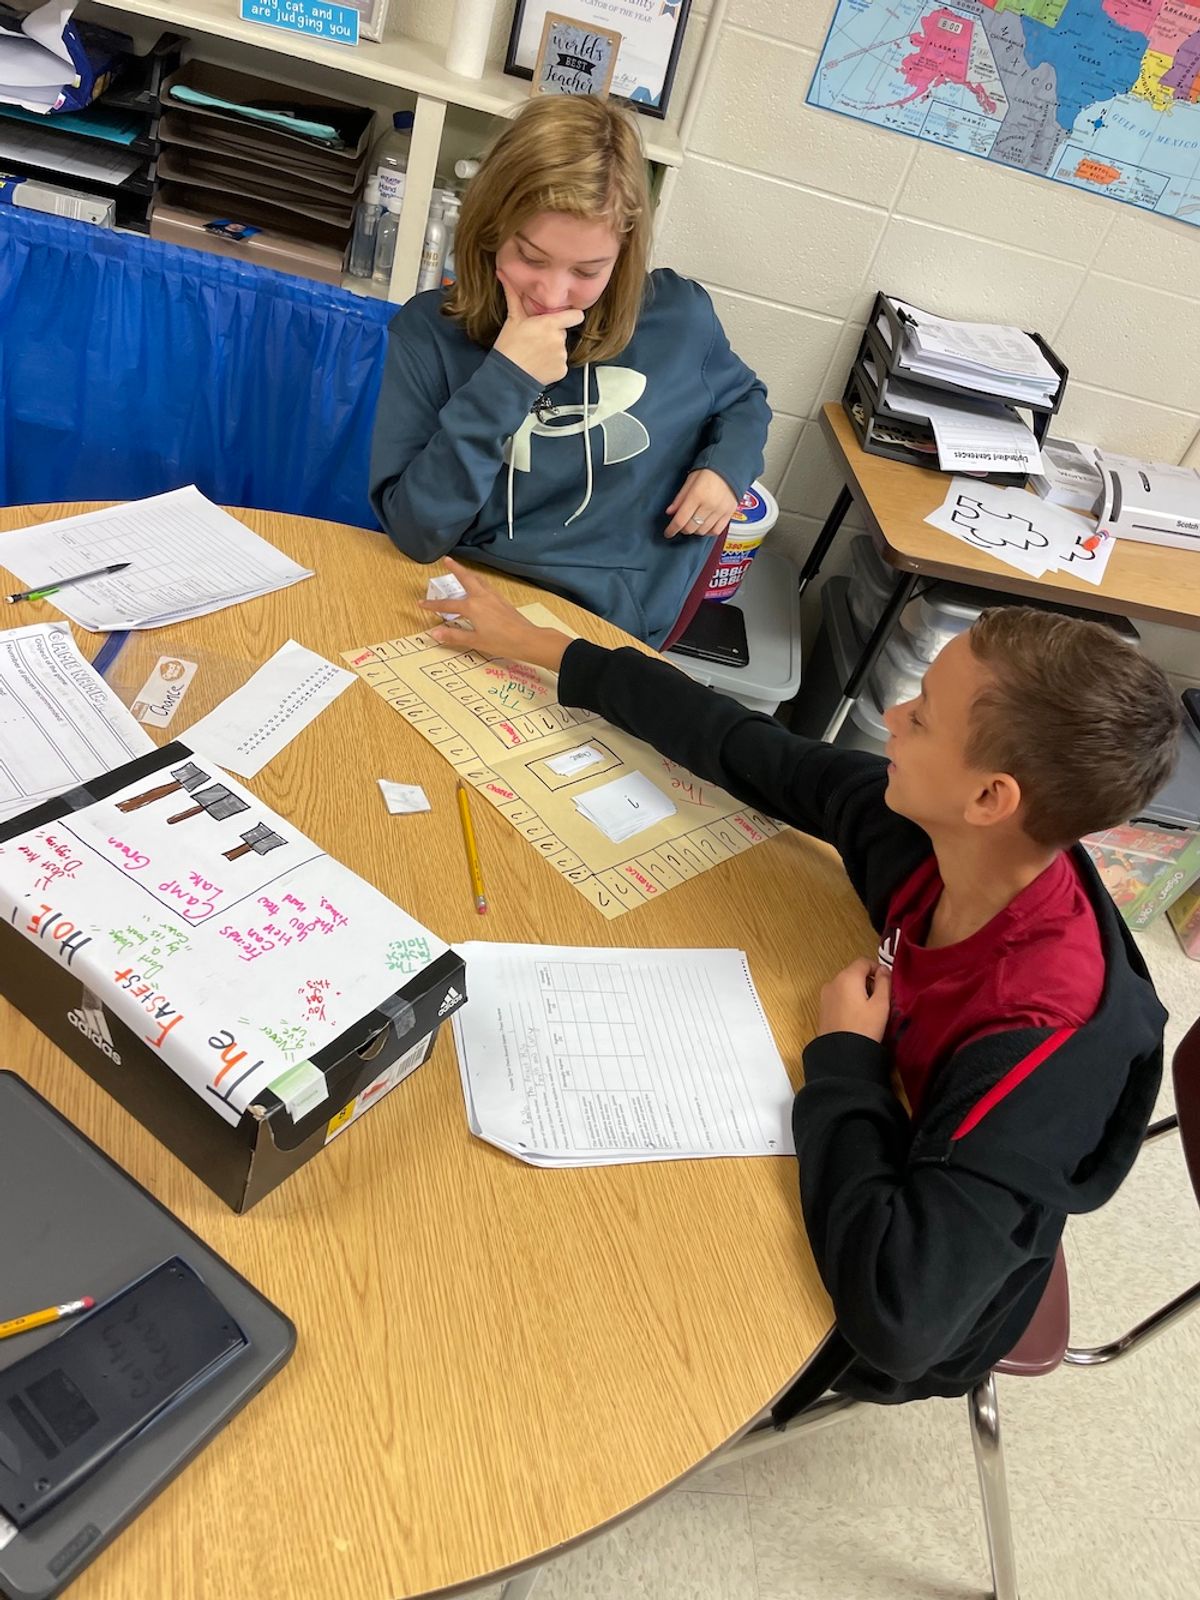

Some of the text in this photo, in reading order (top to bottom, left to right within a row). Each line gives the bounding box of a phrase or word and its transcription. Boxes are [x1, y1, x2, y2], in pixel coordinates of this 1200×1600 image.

[252, 6, 351, 36] are judging you
[286, 1, 304, 13] cat
[312, 8, 332, 20] and
[339, 12, 343, 23] I
[929, 41, 957, 53] ALASKA
[565, 58, 588, 71] BEST
[1077, 54, 1101, 67] TEXAS
[544, 64, 594, 94] Teacher
[1112, 113, 1199, 149] GULF OF MEXICO
[1176, 519, 1200, 531] Scotch
[150, 684, 185, 717] Chance
[488, 686, 522, 712] The
[671, 777, 716, 809] The
[107, 837, 151, 870] Green
[315, 916, 335, 936] the
[247, 928, 275, 951] Can
[437, 993, 464, 1017] adidas
[67, 1010, 122, 1066] adidas
[206, 1030, 264, 1117] The
